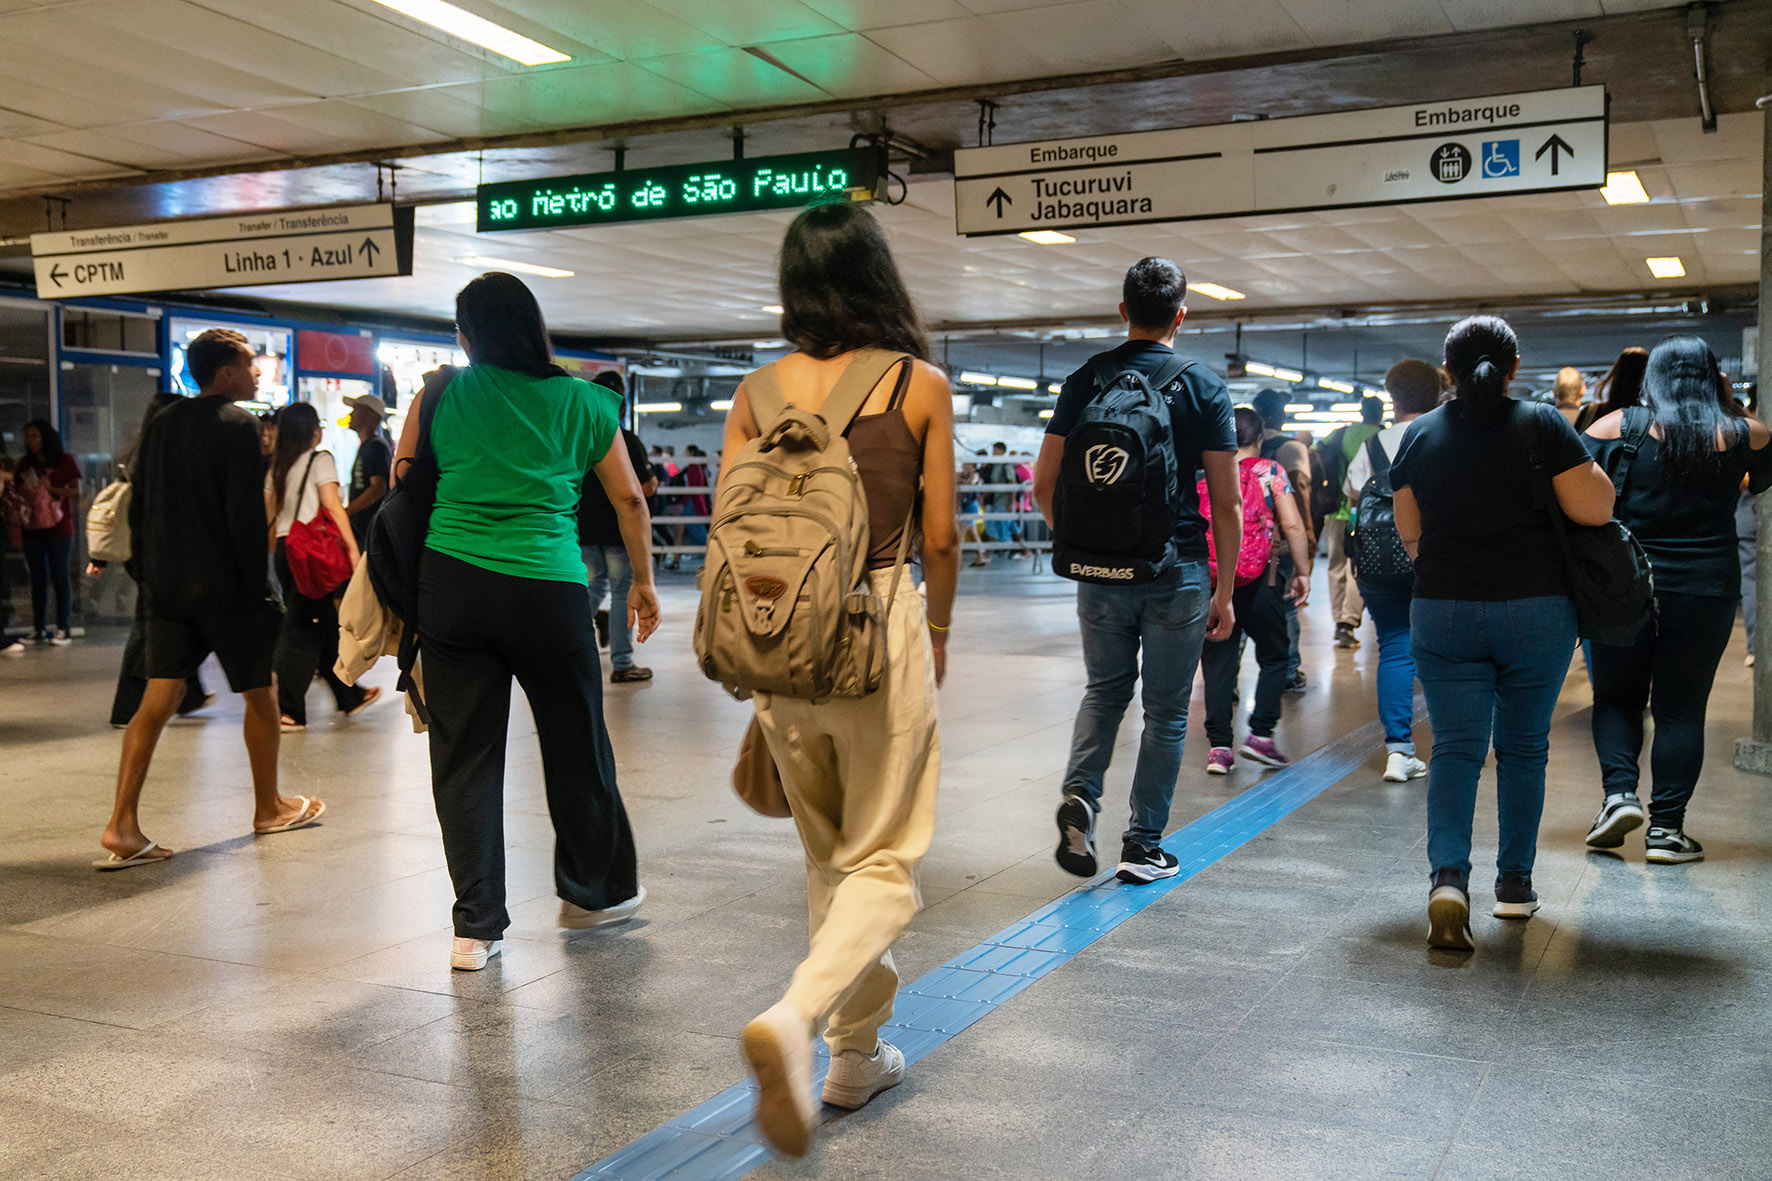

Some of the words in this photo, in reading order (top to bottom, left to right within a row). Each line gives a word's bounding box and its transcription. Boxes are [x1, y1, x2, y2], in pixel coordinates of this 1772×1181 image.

[1415, 104, 1521, 128] Embarque
[1031, 144, 1118, 163] Embarque
[1031, 171, 1132, 198] Tucuruvi
[490, 199, 517, 220] ao
[631, 180, 667, 208] de
[682, 174, 738, 204] São
[1031, 196, 1153, 222] Jabaquara
[238, 220, 272, 233] Transfer
[279, 213, 349, 230] Transferência
[71, 232, 132, 248] Transferência
[138, 231, 169, 243] Transfer
[224, 250, 276, 274] Linha
[282, 249, 291, 270] 1
[311, 244, 353, 268] Azul
[75, 262, 124, 284] CPTM
[1070, 563, 1134, 581] EVERBAGS
